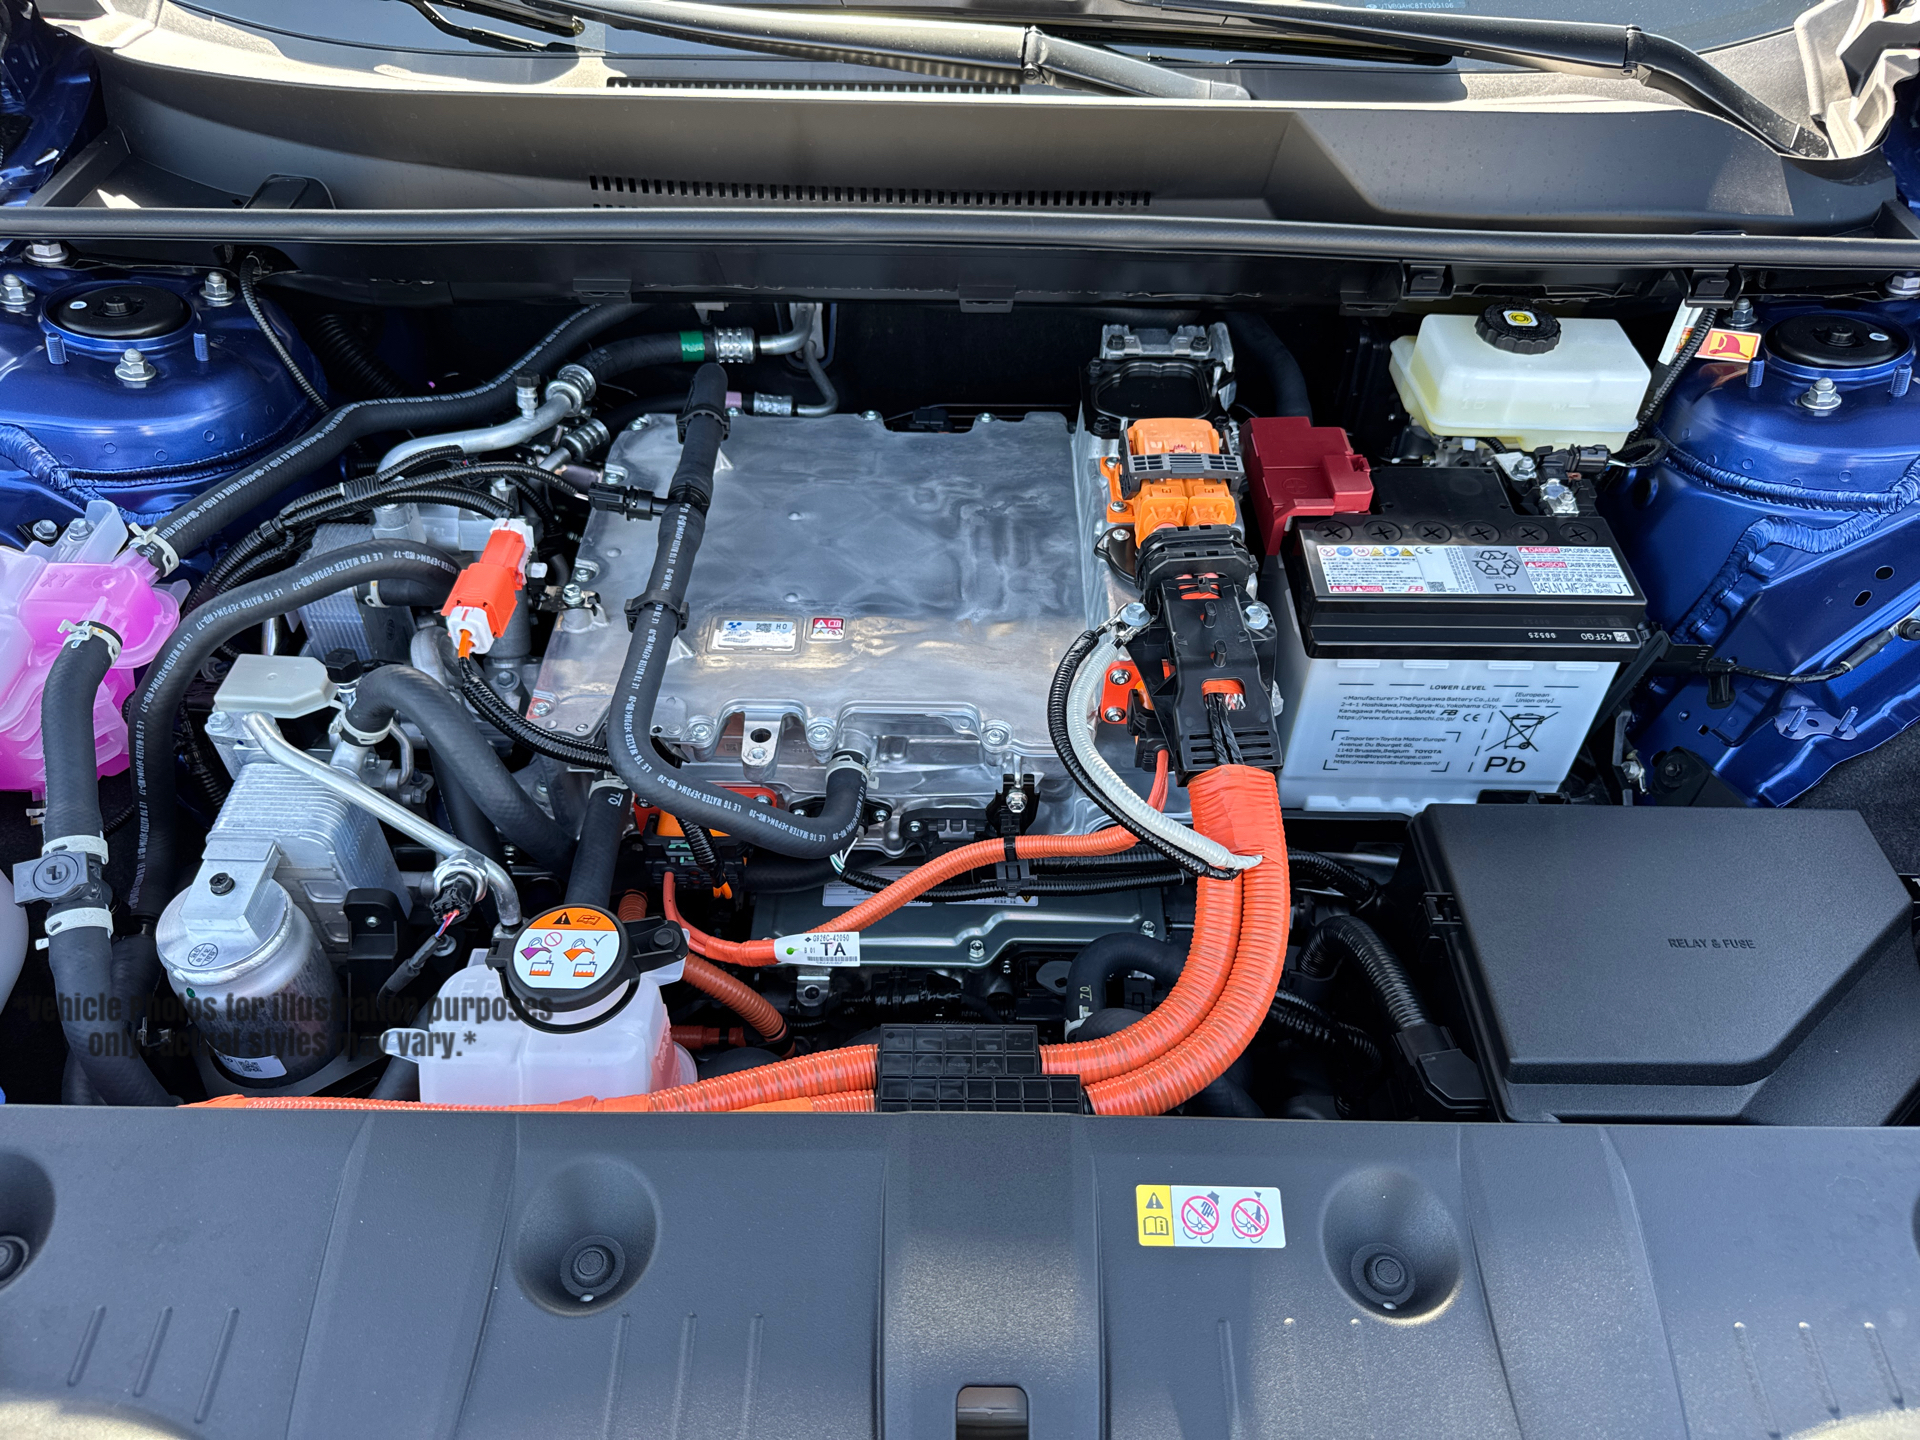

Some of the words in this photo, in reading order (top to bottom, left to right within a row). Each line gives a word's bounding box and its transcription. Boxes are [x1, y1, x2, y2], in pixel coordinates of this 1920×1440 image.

[1528, 546, 1559, 554] DANGER
[1494, 583, 1517, 592] Pb
[1483, 756, 1526, 774] Pb
[701, 793, 723, 807] WATER
[732, 802, 742, 813] LE
[788, 825, 809, 839] WATER
[818, 834, 826, 842] LE
[820, 942, 847, 956] TA
[1667, 938, 1707, 949] RELAY
[1711, 938, 1721, 949] &
[1722, 938, 1757, 949] FUSE
[1079, 986, 1091, 999] 70
